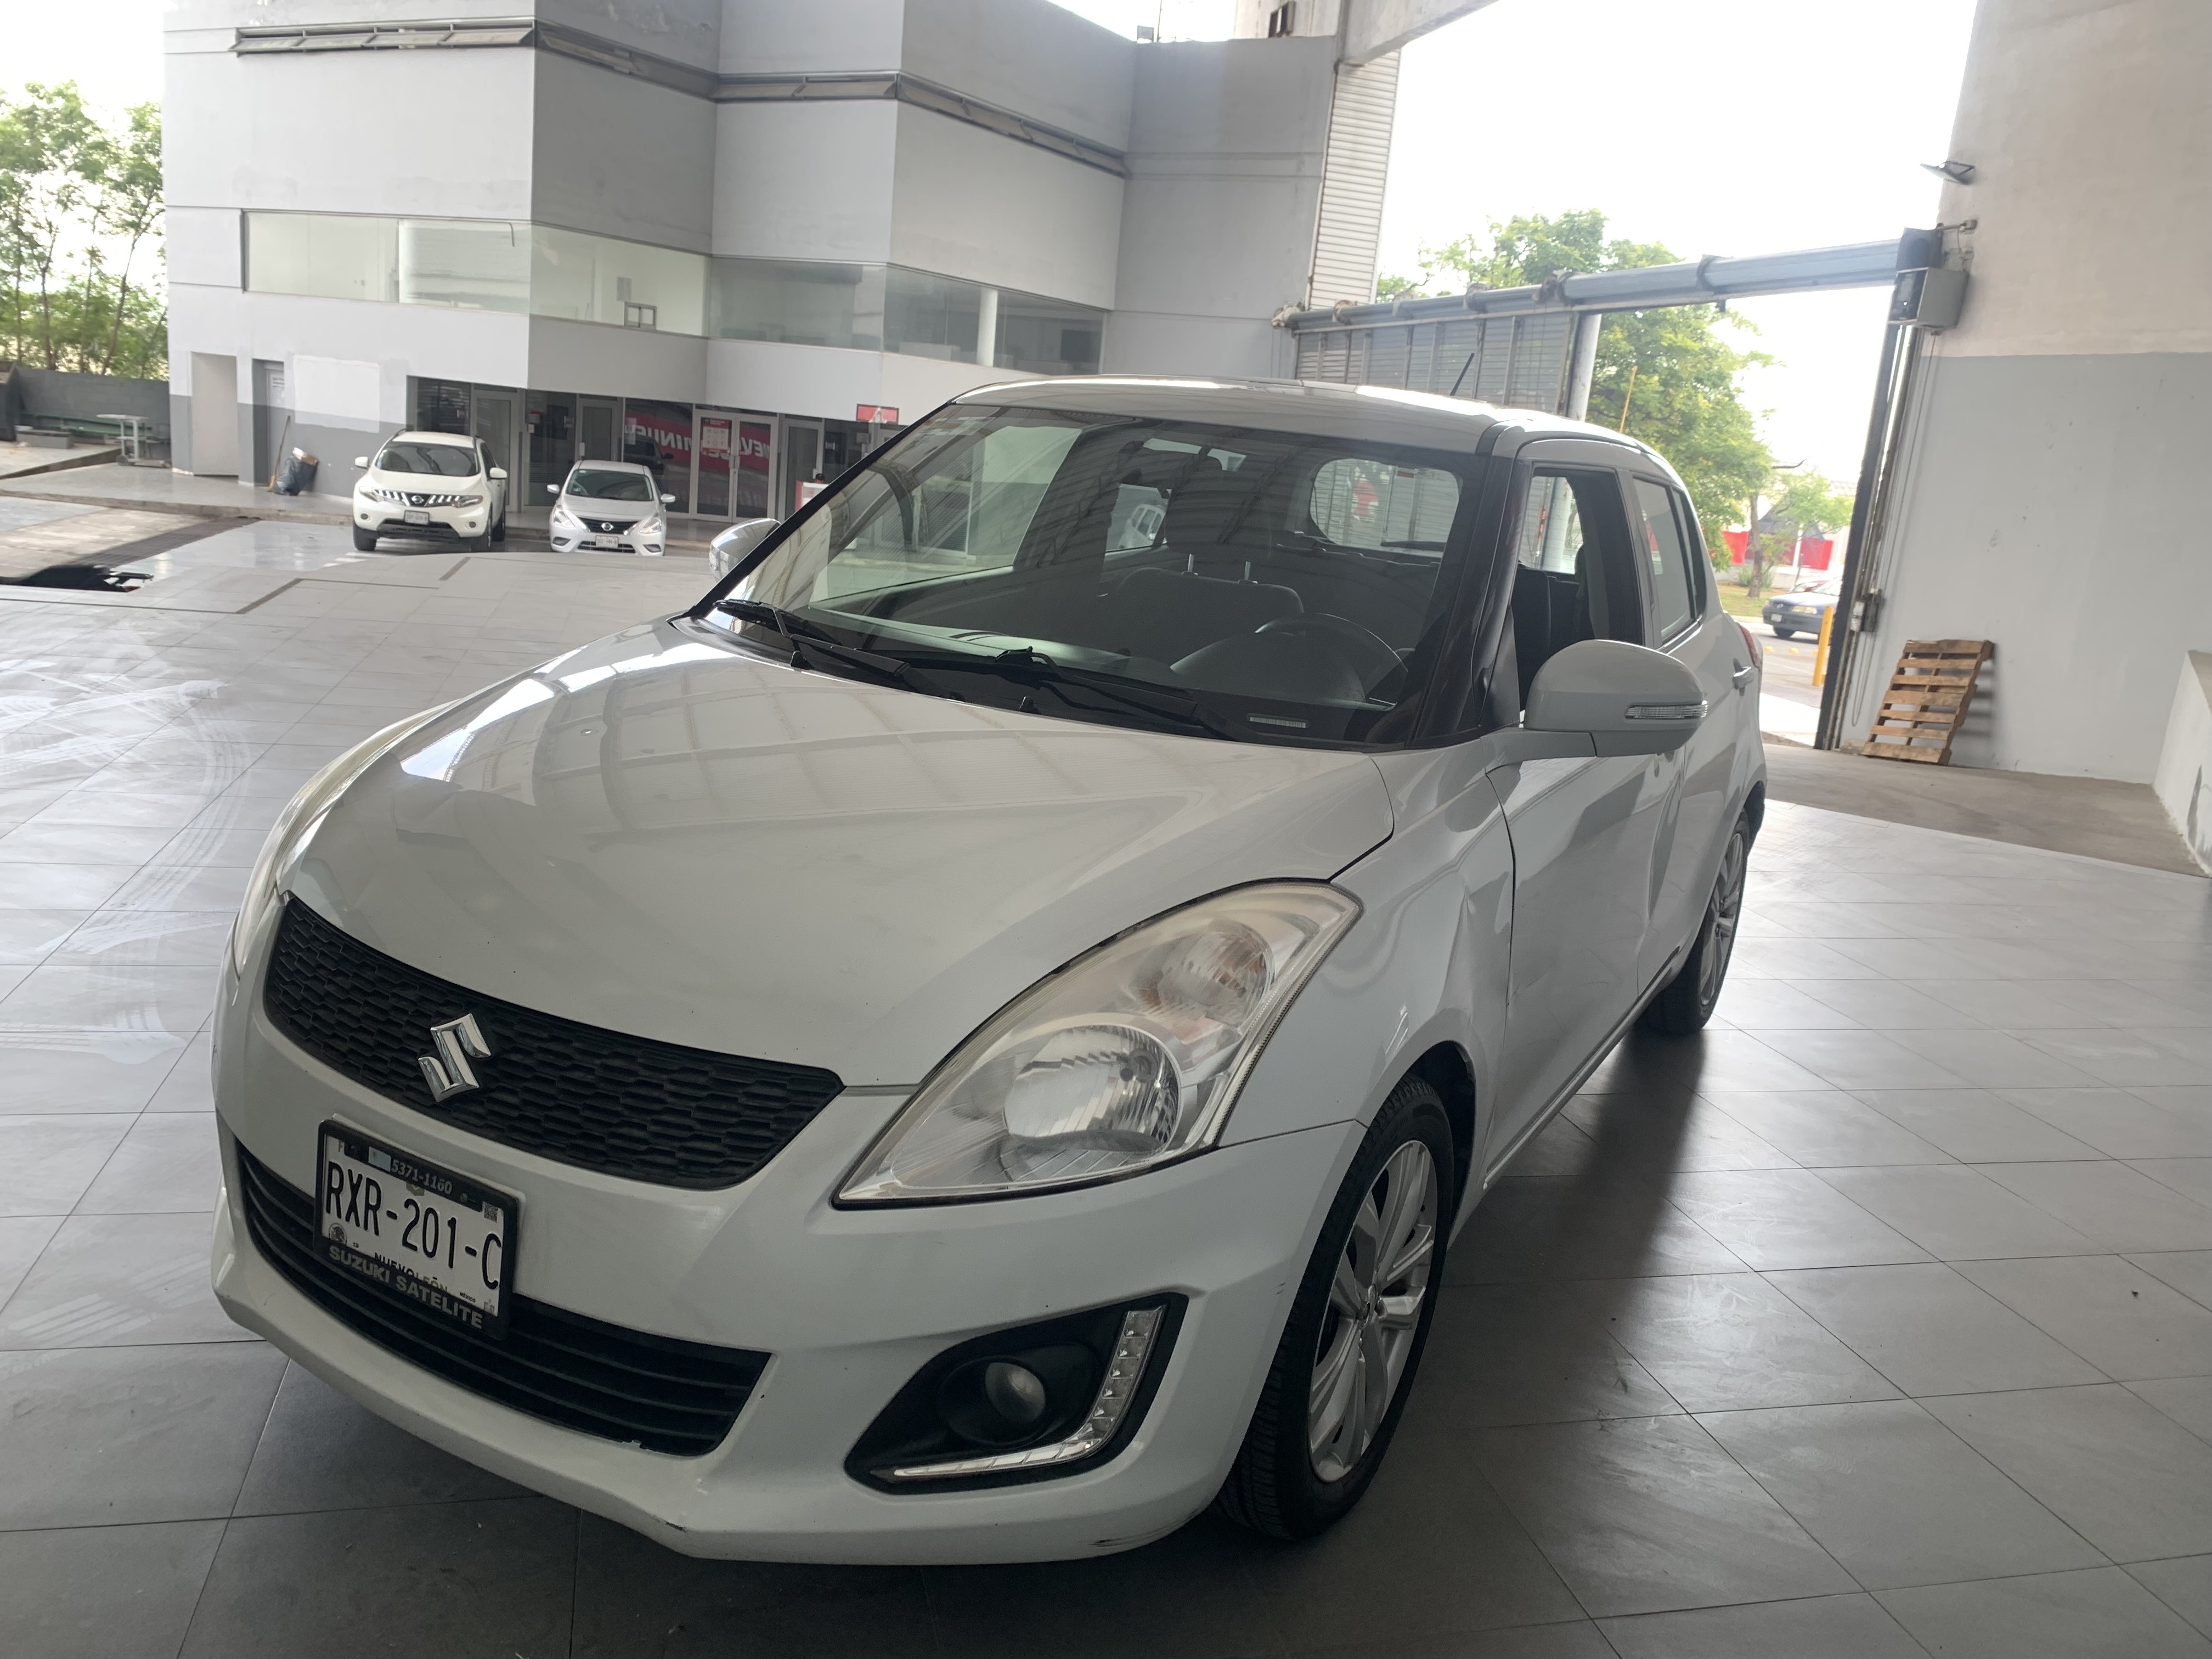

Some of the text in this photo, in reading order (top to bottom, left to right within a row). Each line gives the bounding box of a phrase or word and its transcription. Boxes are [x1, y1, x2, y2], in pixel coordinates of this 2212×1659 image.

[391, 1159, 453, 1195] 5371-1160
[326, 1161, 502, 1290] RXR-201-C
[329, 1245, 483, 1330] SUZUKI SATELITE
[459, 1291, 476, 1303] MÉXICO
